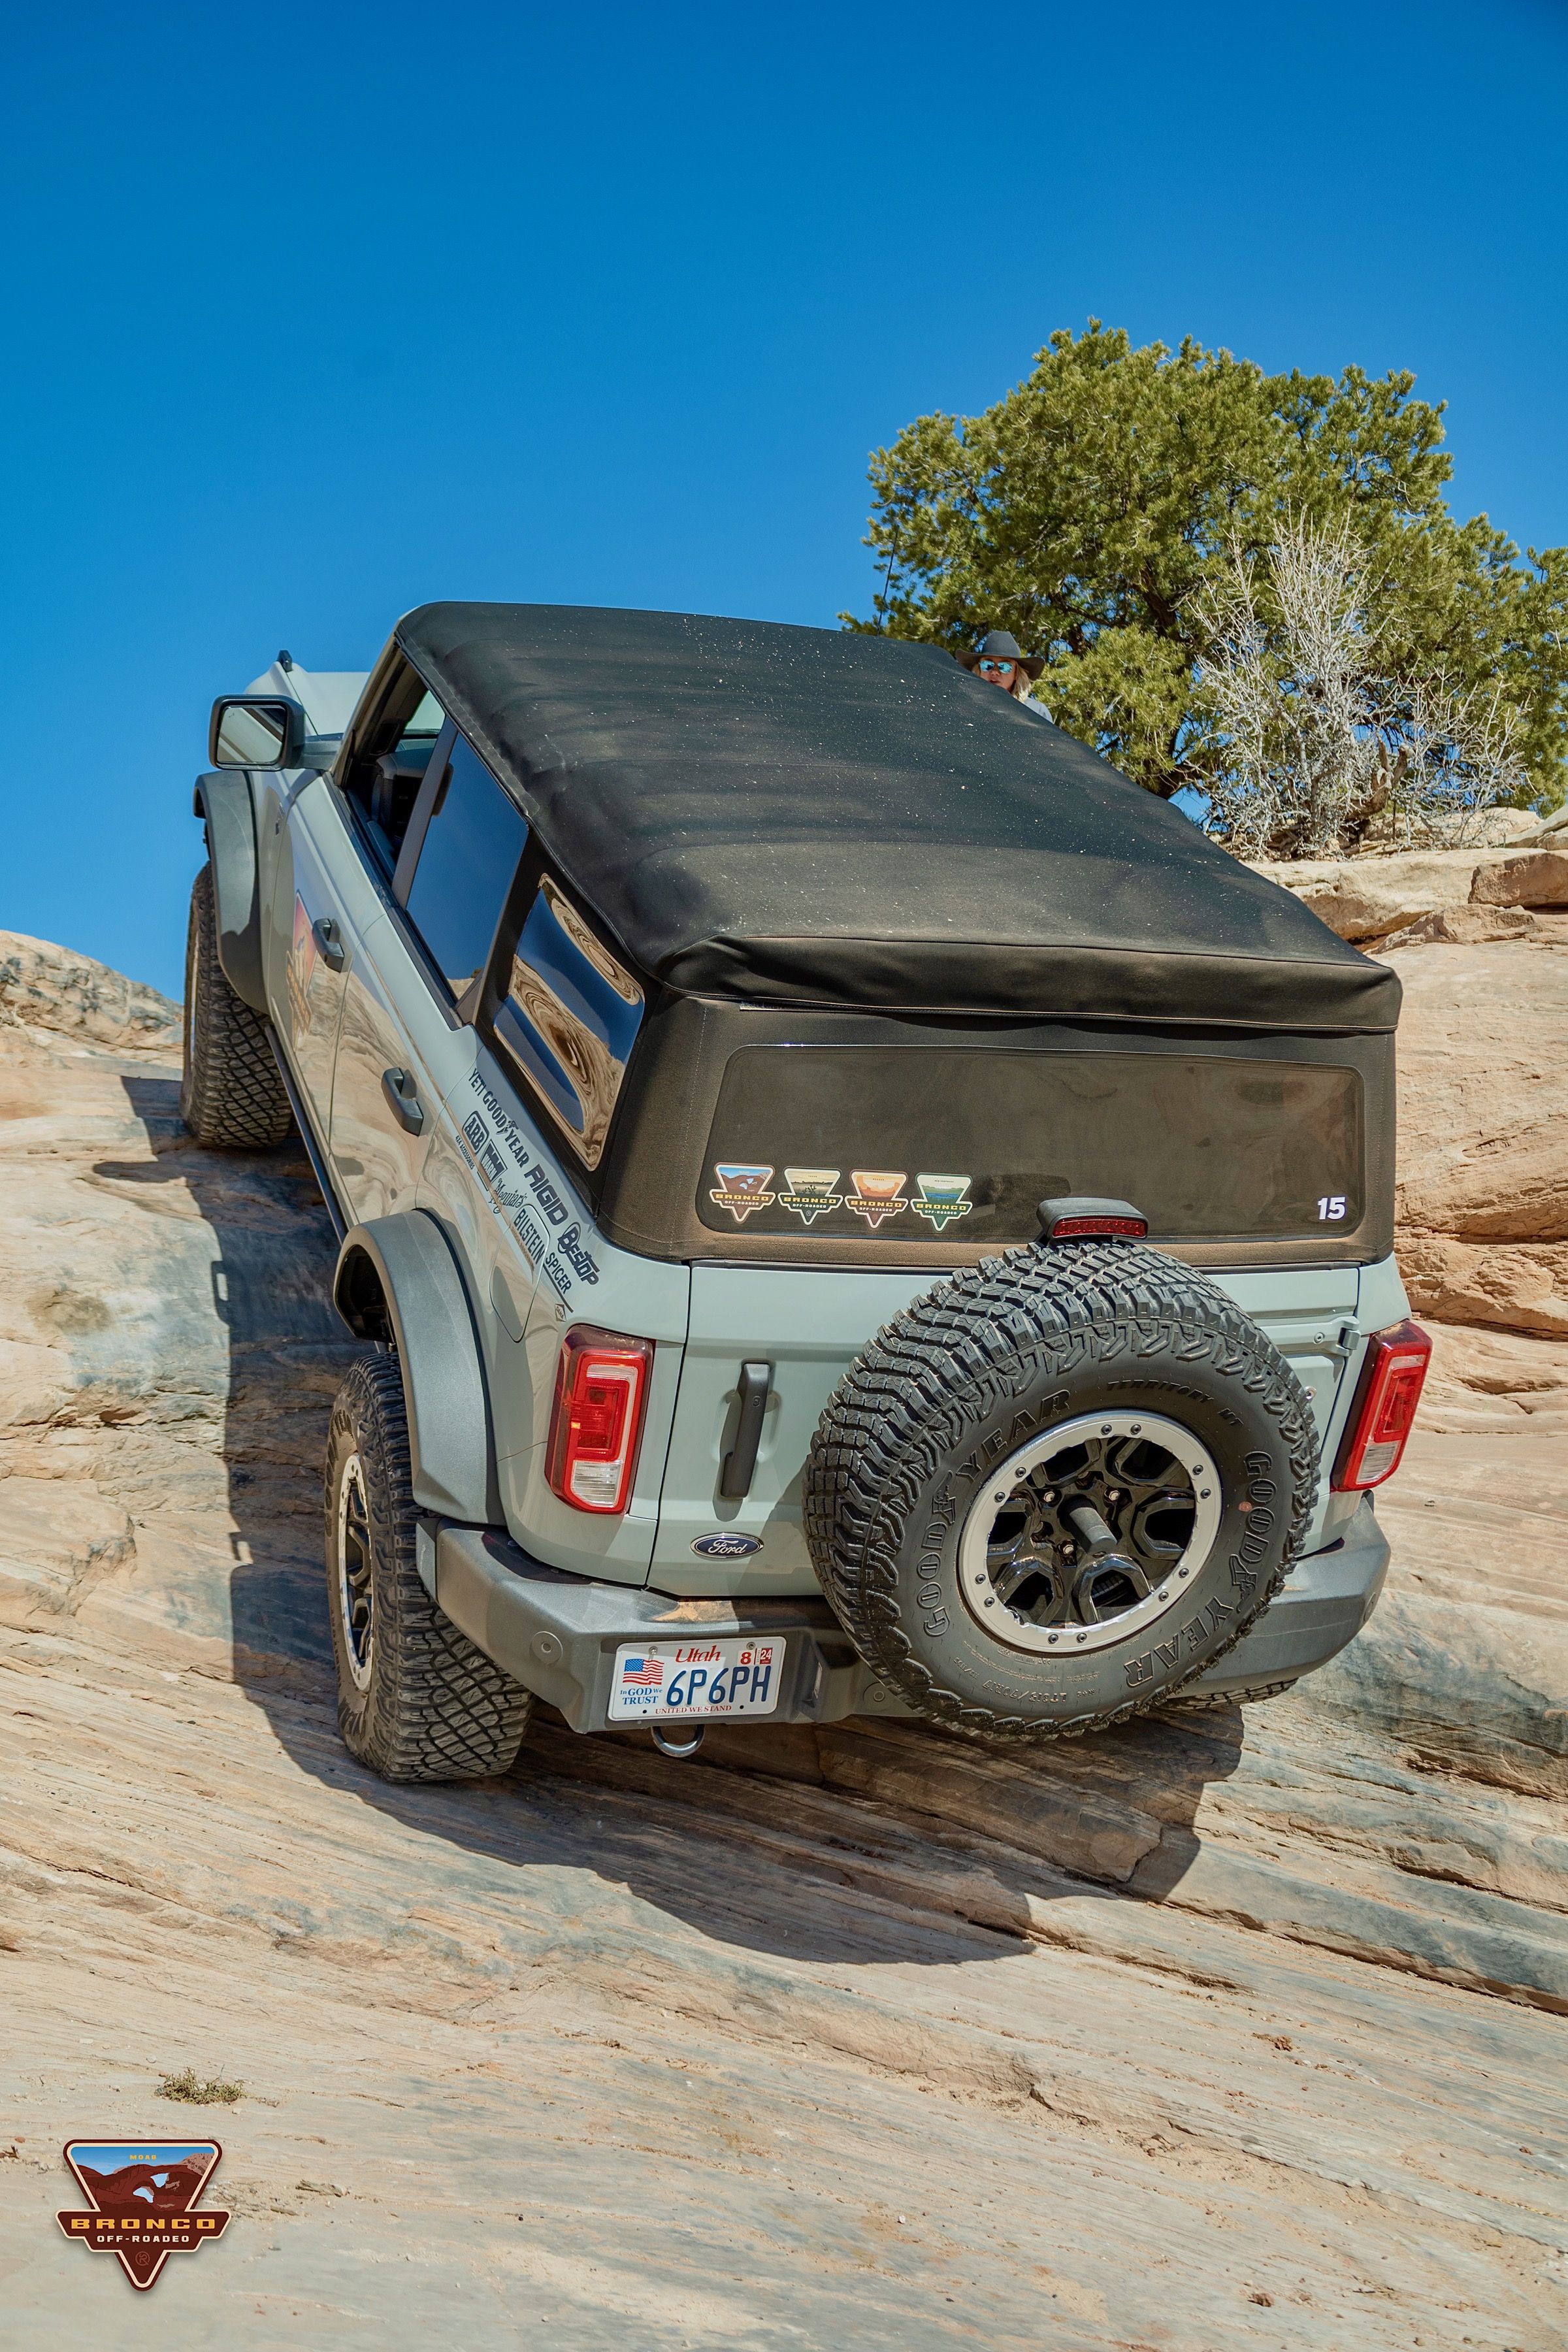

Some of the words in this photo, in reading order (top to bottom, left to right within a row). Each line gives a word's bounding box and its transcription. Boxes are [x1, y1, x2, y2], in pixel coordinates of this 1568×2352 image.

[468, 1068, 486, 1096] YETI
[464, 1117, 485, 1151] ARB
[460, 1144, 475, 1169] ACCESSORIES
[482, 1154, 497, 1181] WARN
[523, 1164, 569, 1226] RIGID
[1317, 1197, 1345, 1220] 15
[514, 1208, 546, 1264] BILSTEIN
[546, 1252, 572, 1294] SPICER
[1107, 1379, 1215, 1404] TERRITORY
[1217, 1407, 1244, 1426] MT
[708, 1539, 747, 1554] Ford
[675, 1645, 721, 1663] Utah
[740, 1652, 751, 1665] 8
[761, 1650, 772, 1659] 24
[628, 1688, 653, 1696] GOD
[666, 1665, 772, 1707] 6P6PH
[623, 1696, 659, 1705] TRUST
